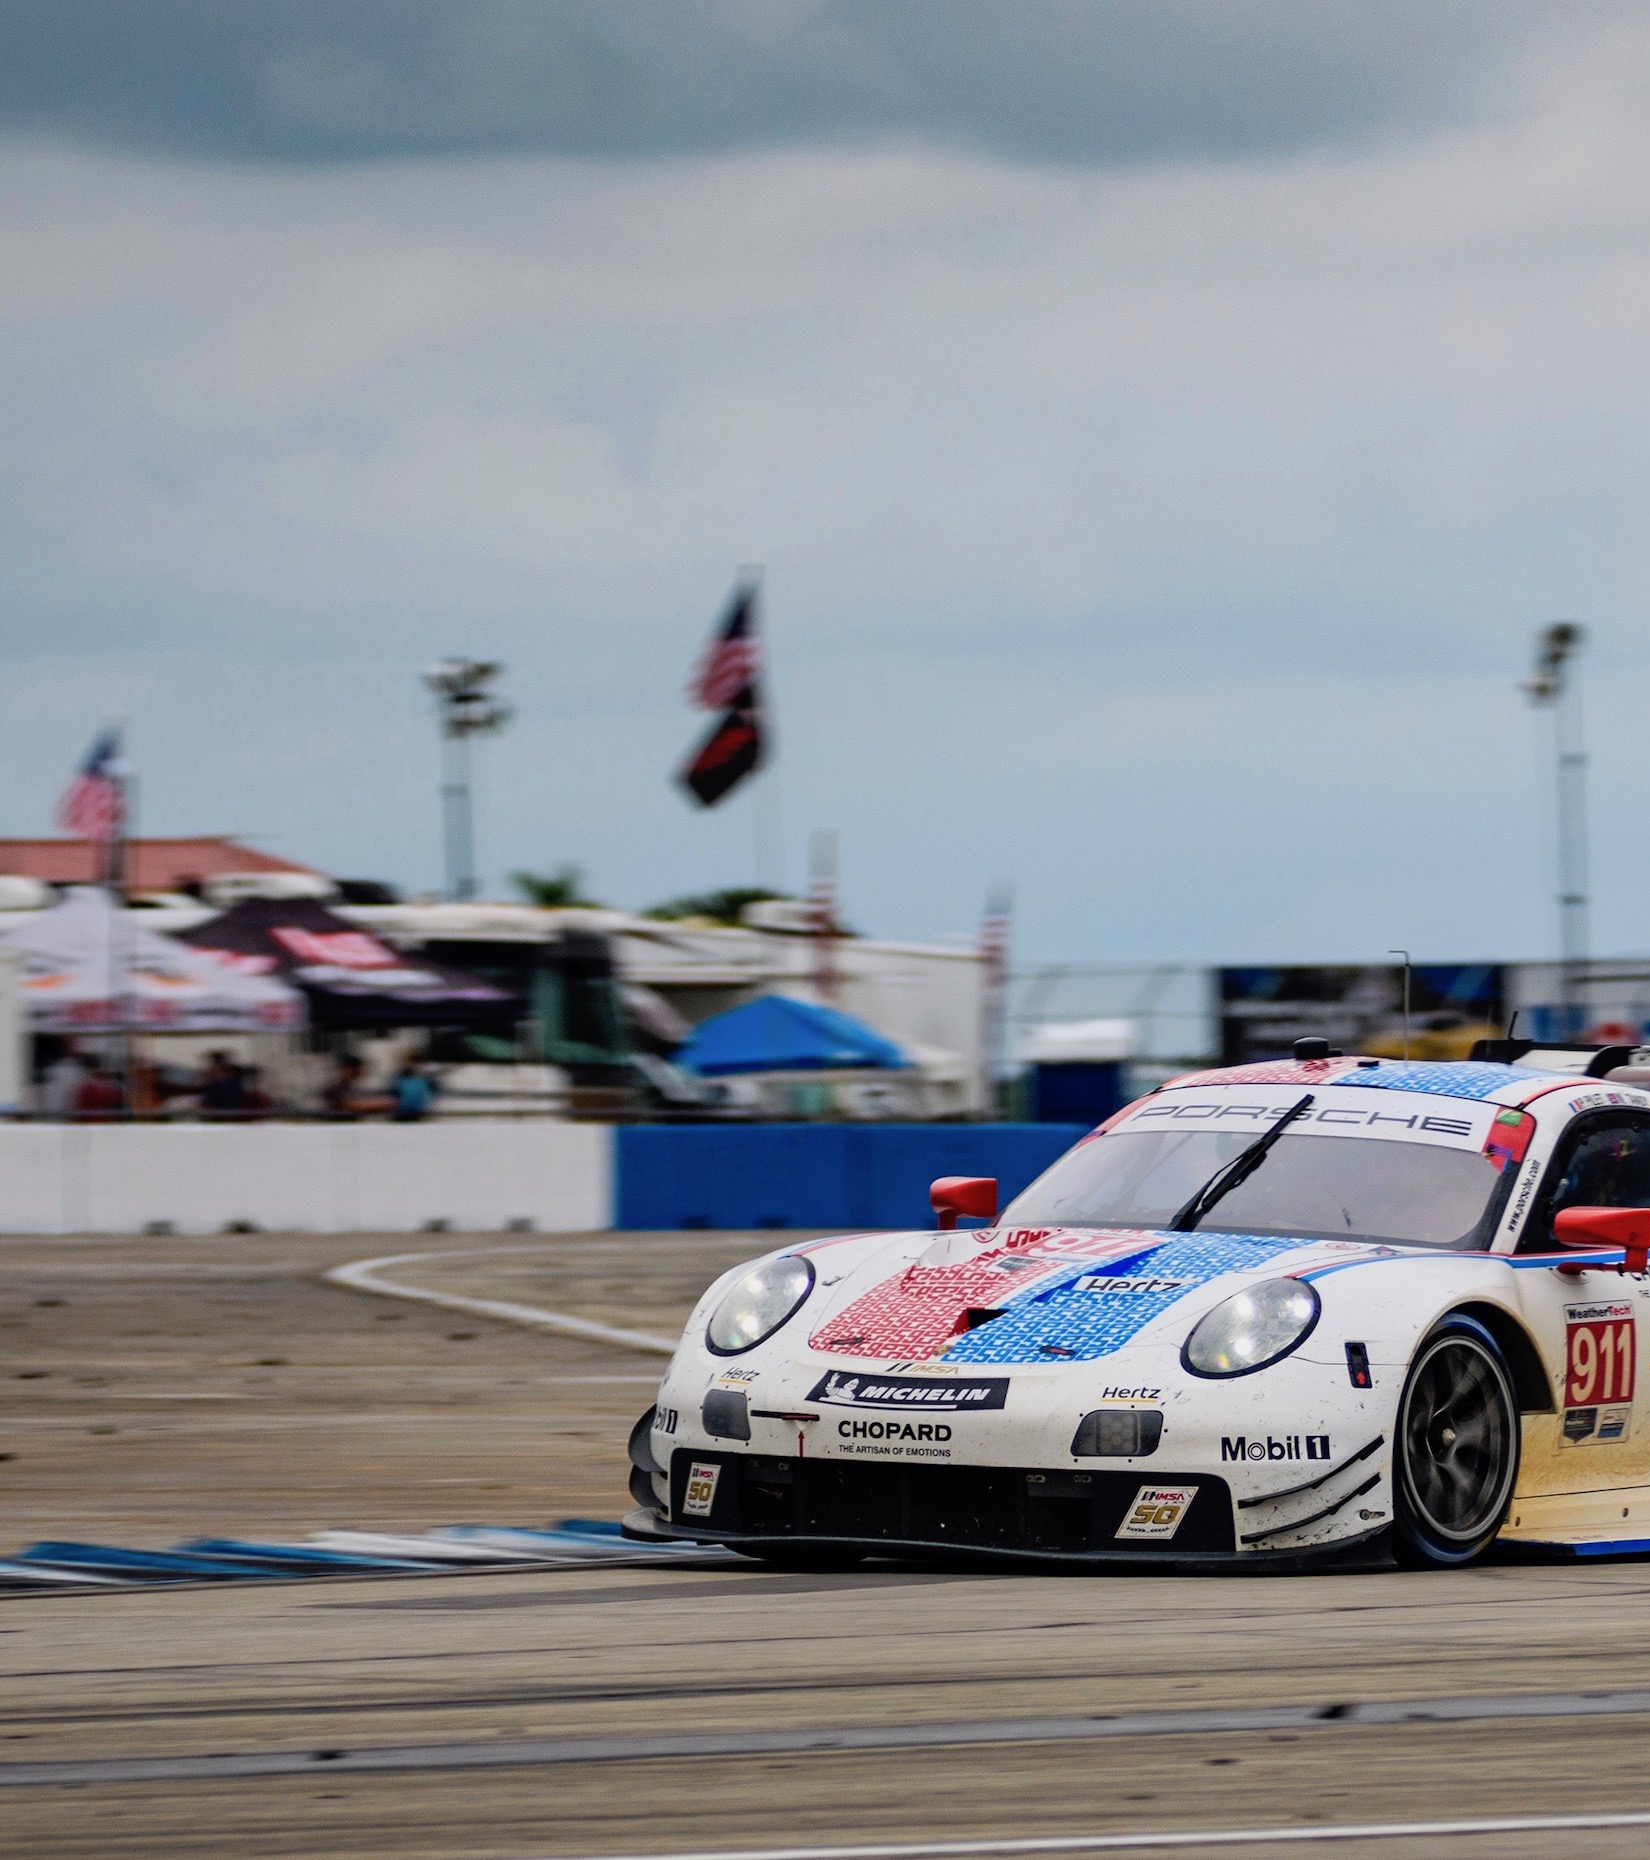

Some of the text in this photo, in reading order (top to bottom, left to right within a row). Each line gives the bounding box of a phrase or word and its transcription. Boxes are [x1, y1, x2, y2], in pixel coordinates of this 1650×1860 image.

[1131, 1104, 1472, 1136] PORSCHE
[1086, 1277, 1182, 1292] Hertz
[1567, 1304, 1631, 1320] WeatherTech
[1571, 1323, 1632, 1402] 911
[722, 1366, 761, 1381] Hertz
[859, 1385, 991, 1401] MICHELIN
[1102, 1387, 1162, 1399] Hertz
[837, 1420, 953, 1442] CHOPARD
[838, 1444, 951, 1458] THE ARTISAN OF EMOTIONS
[1221, 1436, 1328, 1461] Mobil 1
[688, 1481, 712, 1502] 50
[1155, 1492, 1185, 1501] IMSA
[1130, 1505, 1181, 1525] 50
